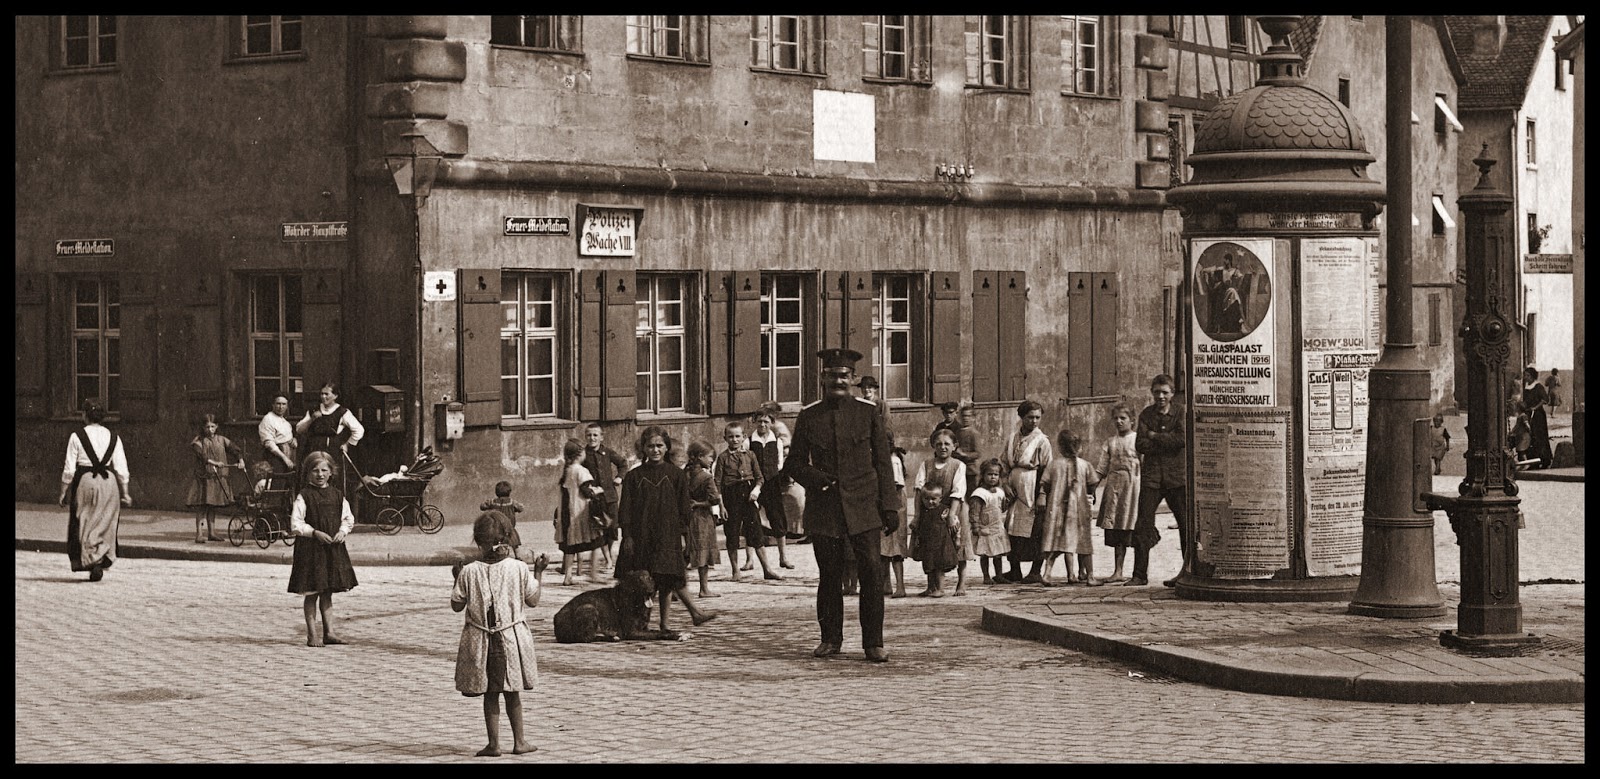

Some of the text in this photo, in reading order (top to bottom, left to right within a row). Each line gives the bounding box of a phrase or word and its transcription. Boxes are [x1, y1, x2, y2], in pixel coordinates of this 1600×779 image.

[588, 211, 631, 232] Polizei
[284, 225, 310, 237] Wöhrder
[586, 232, 633, 253] Wache VIII.
[1210, 344, 1263, 354] GLASPALAST
[1206, 354, 1248, 364] MÜNCHEN
[1194, 367, 1271, 378] JAHRESAUSSTELLUNG
[1209, 385, 1245, 394] MÜNCHENER
